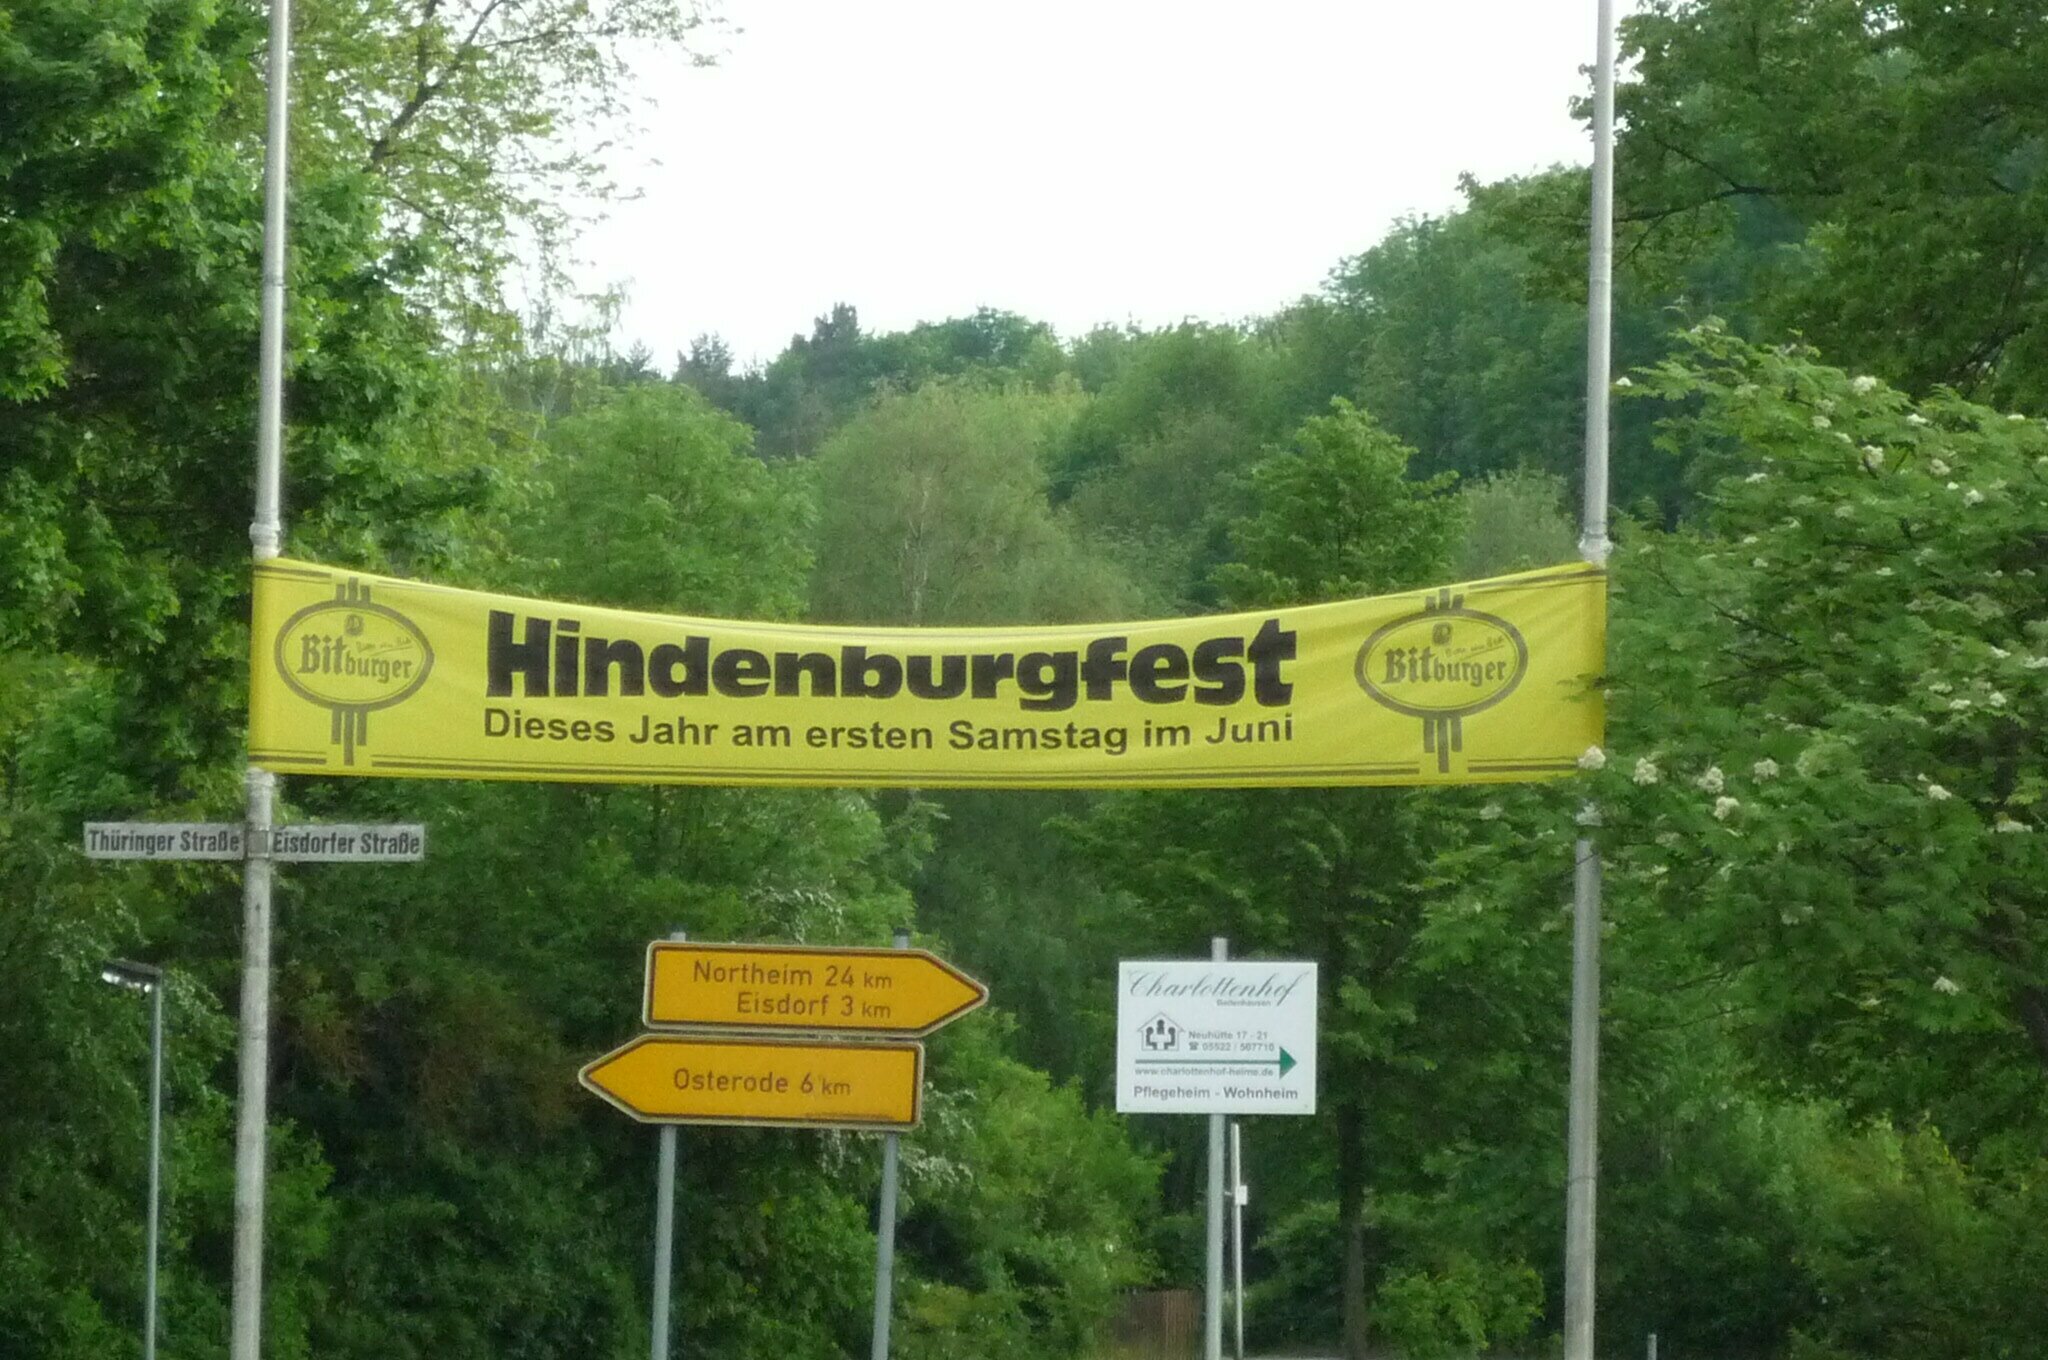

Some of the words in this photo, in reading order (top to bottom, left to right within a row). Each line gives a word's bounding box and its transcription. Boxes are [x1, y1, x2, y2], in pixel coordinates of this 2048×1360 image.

[297, 633, 412, 685] Bitburger
[486, 609, 1297, 712] Hindenburgfest
[1381, 645, 1507, 688] Bitburger
[484, 707, 615, 743] Dieses
[628, 714, 719, 747] Jahr
[731, 725, 791, 748] am
[805, 722, 933, 750] ersten
[948, 719, 1128, 756] Samstag
[1143, 719, 1192, 748] im
[1205, 713, 1293, 745] Juni
[89, 829, 175, 855] Thüringer
[179, 831, 240, 852] Straße
[272, 831, 355, 854] Eisdorfer
[360, 833, 420, 855] Straße
[693, 961, 813, 986] Northeim
[825, 965, 854, 988] 24
[863, 970, 892, 989] km
[1127, 970, 1309, 1007] Charlottenhof
[736, 991, 829, 1016] Eisdorf
[840, 995, 853, 1018] 3
[862, 1001, 891, 1019] km
[1188, 1030, 1233, 1039] Neuhütte
[1236, 1030, 1247, 1039] 17
[1256, 1031, 1268, 1040] 21
[674, 1069, 788, 1093] Osterode
[801, 1073, 813, 1095] 6
[821, 1077, 851, 1096] km
[1134, 1086, 1210, 1100] Pflegeheim
[1223, 1087, 1298, 1099] Wohnheim
